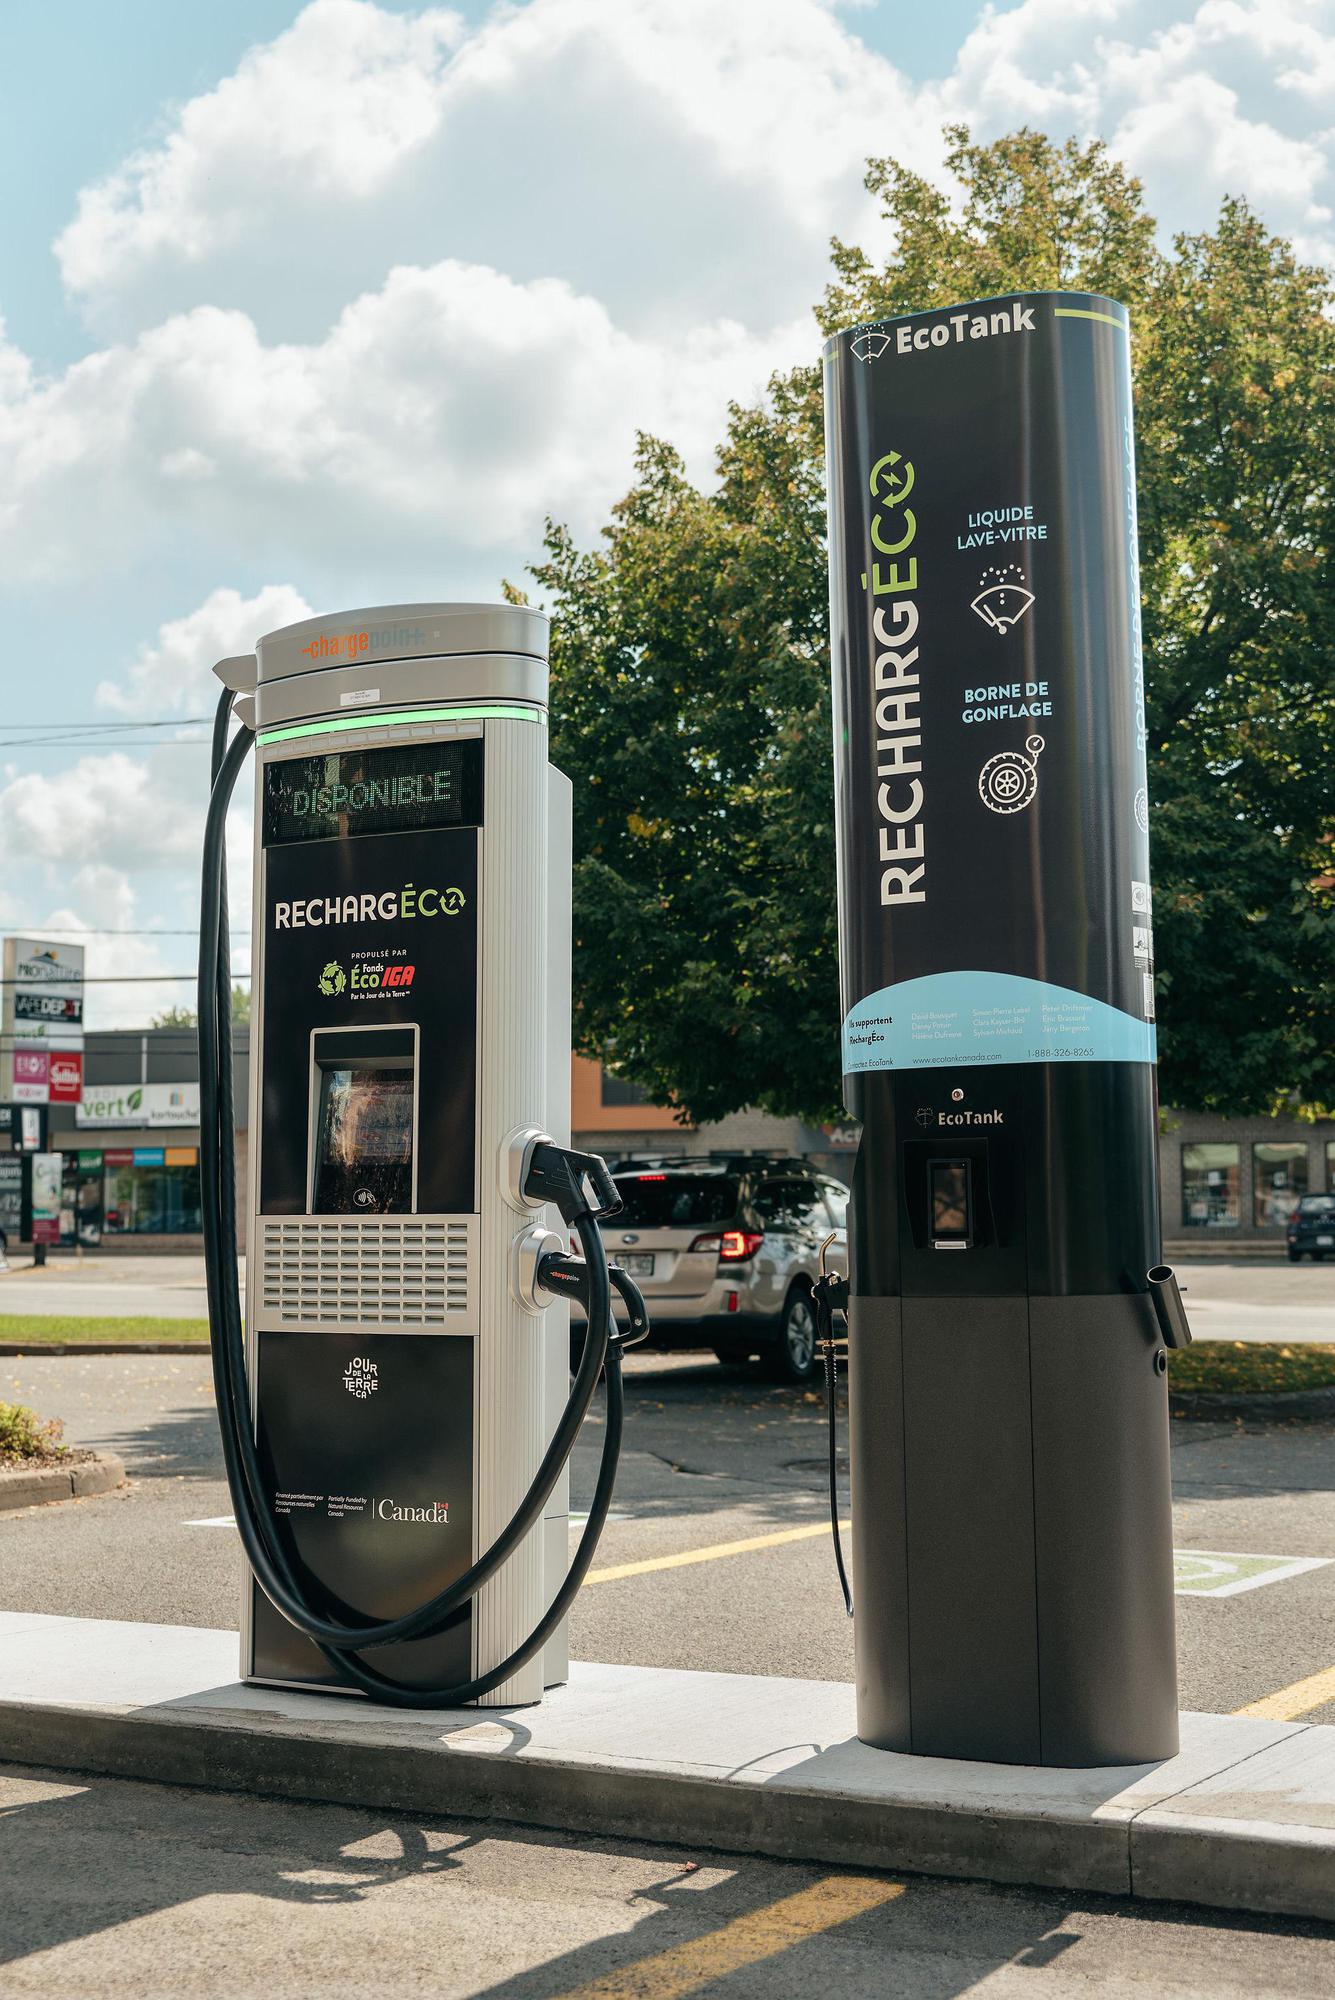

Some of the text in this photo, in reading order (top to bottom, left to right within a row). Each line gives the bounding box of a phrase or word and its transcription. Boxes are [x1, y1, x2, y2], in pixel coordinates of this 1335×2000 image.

[896, 303, 1036, 354] EcoTank
[968, 506, 1034, 528] LIQUIDE
[957, 525, 1048, 550] LAVE-VITRE
[964, 681, 1049, 703] BORNE DE
[962, 701, 1052, 724] GONFLAGE
[293, 770, 451, 816] DISPONIBLE
[351, 949, 407, 959] PROPULSÉ PAR
[351, 964, 415, 989] Éco IGA
[363, 963, 384, 973] Fonds
[392, 990, 405, 998] Terre
[855, 1017, 893, 1029] supportent
[850, 1030, 885, 1046] RechargÉco
[913, 1052, 1002, 1065] www.ecotankcanada.com
[1028, 1048, 1095, 1058] 1-888-326-8265
[869, 1058, 894, 1067] EcoTank
[83, 1098, 124, 1117] vert
[938, 1109, 1003, 1126] EcoTank
[344, 1357, 378, 1377] JOUR
[342, 1377, 378, 1395] TERRE
[378, 1498, 449, 1523] Canada
